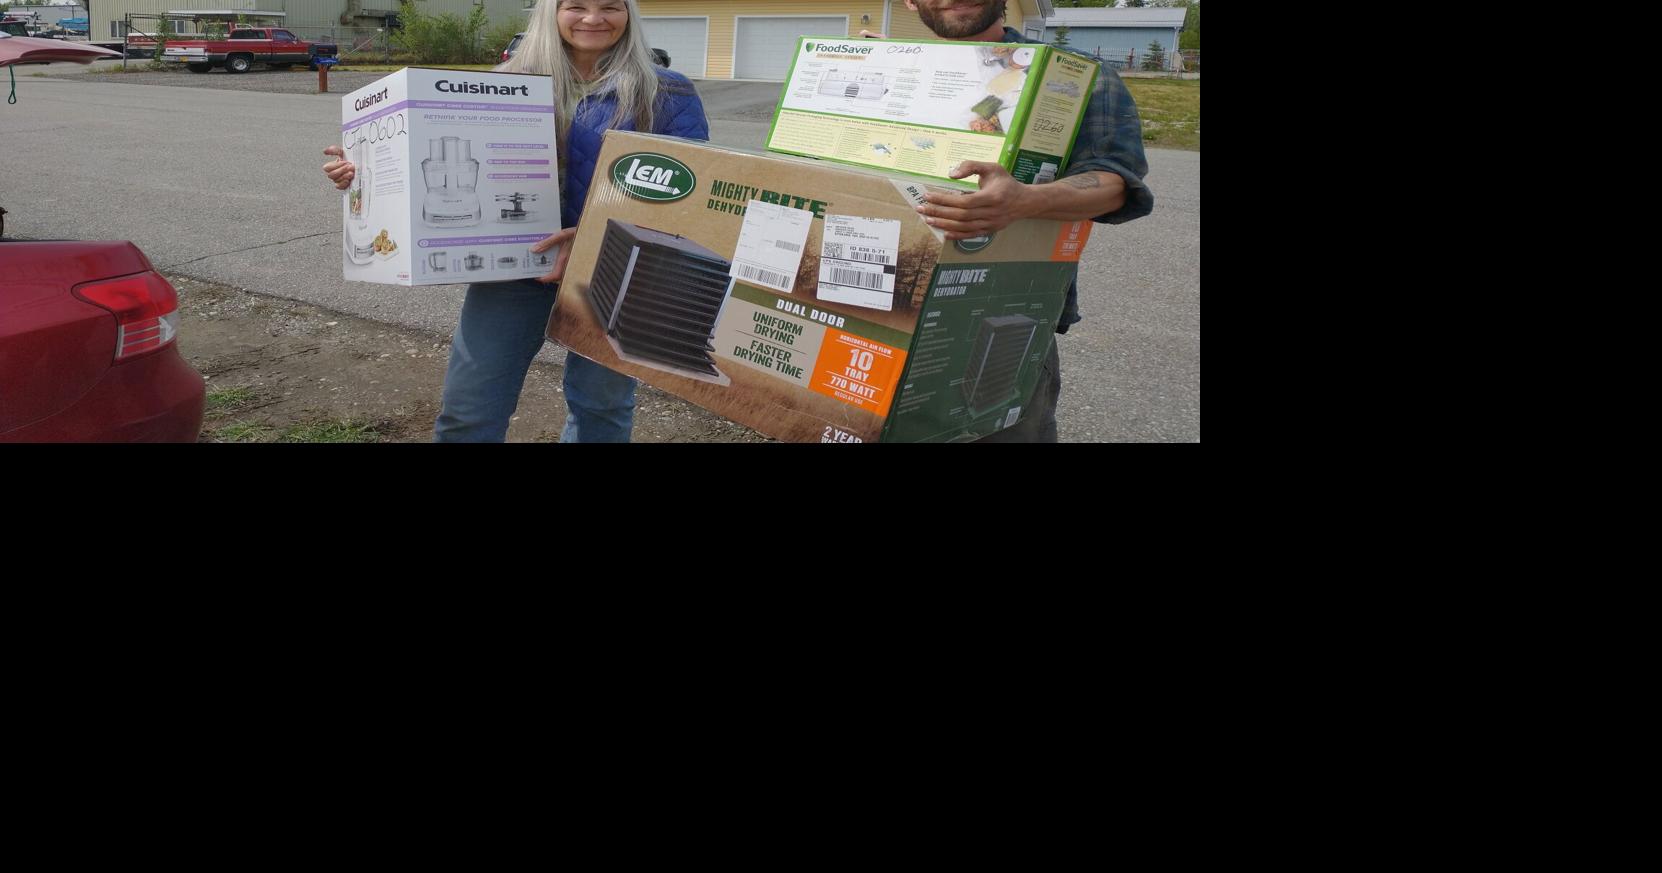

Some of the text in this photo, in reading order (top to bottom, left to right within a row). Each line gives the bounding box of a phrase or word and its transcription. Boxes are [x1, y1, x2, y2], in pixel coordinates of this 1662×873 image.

[815, 43, 873, 55] FoodSaver
[1061, 57, 1088, 71] FoodSaver
[354, 86, 388, 112] Cuisinart
[434, 79, 529, 97] Cuisinart
[423, 113, 456, 121] RETHINK
[624, 158, 675, 190] LEM
[707, 198, 748, 217] DEHYD
[710, 179, 759, 202] MIGHTY
[760, 189, 828, 220] BITE
[937, 268, 989, 286] MIGHTY BITE
[933, 286, 967, 298] DEHYDRATOR
[752, 311, 804, 336] UNIFORM
[776, 298, 845, 328] DUAL DOOR
[753, 323, 795, 346] DRYING
[750, 339, 792, 363] FASTER
[868, 343, 879, 351] AIR
[733, 346, 804, 380] DRYING TIME
[850, 348, 874, 372] 10
[845, 367, 870, 382] TRAY
[830, 375, 876, 399] 770 WATT
[823, 425, 831, 438] 2
[833, 428, 863, 447] YEAR
